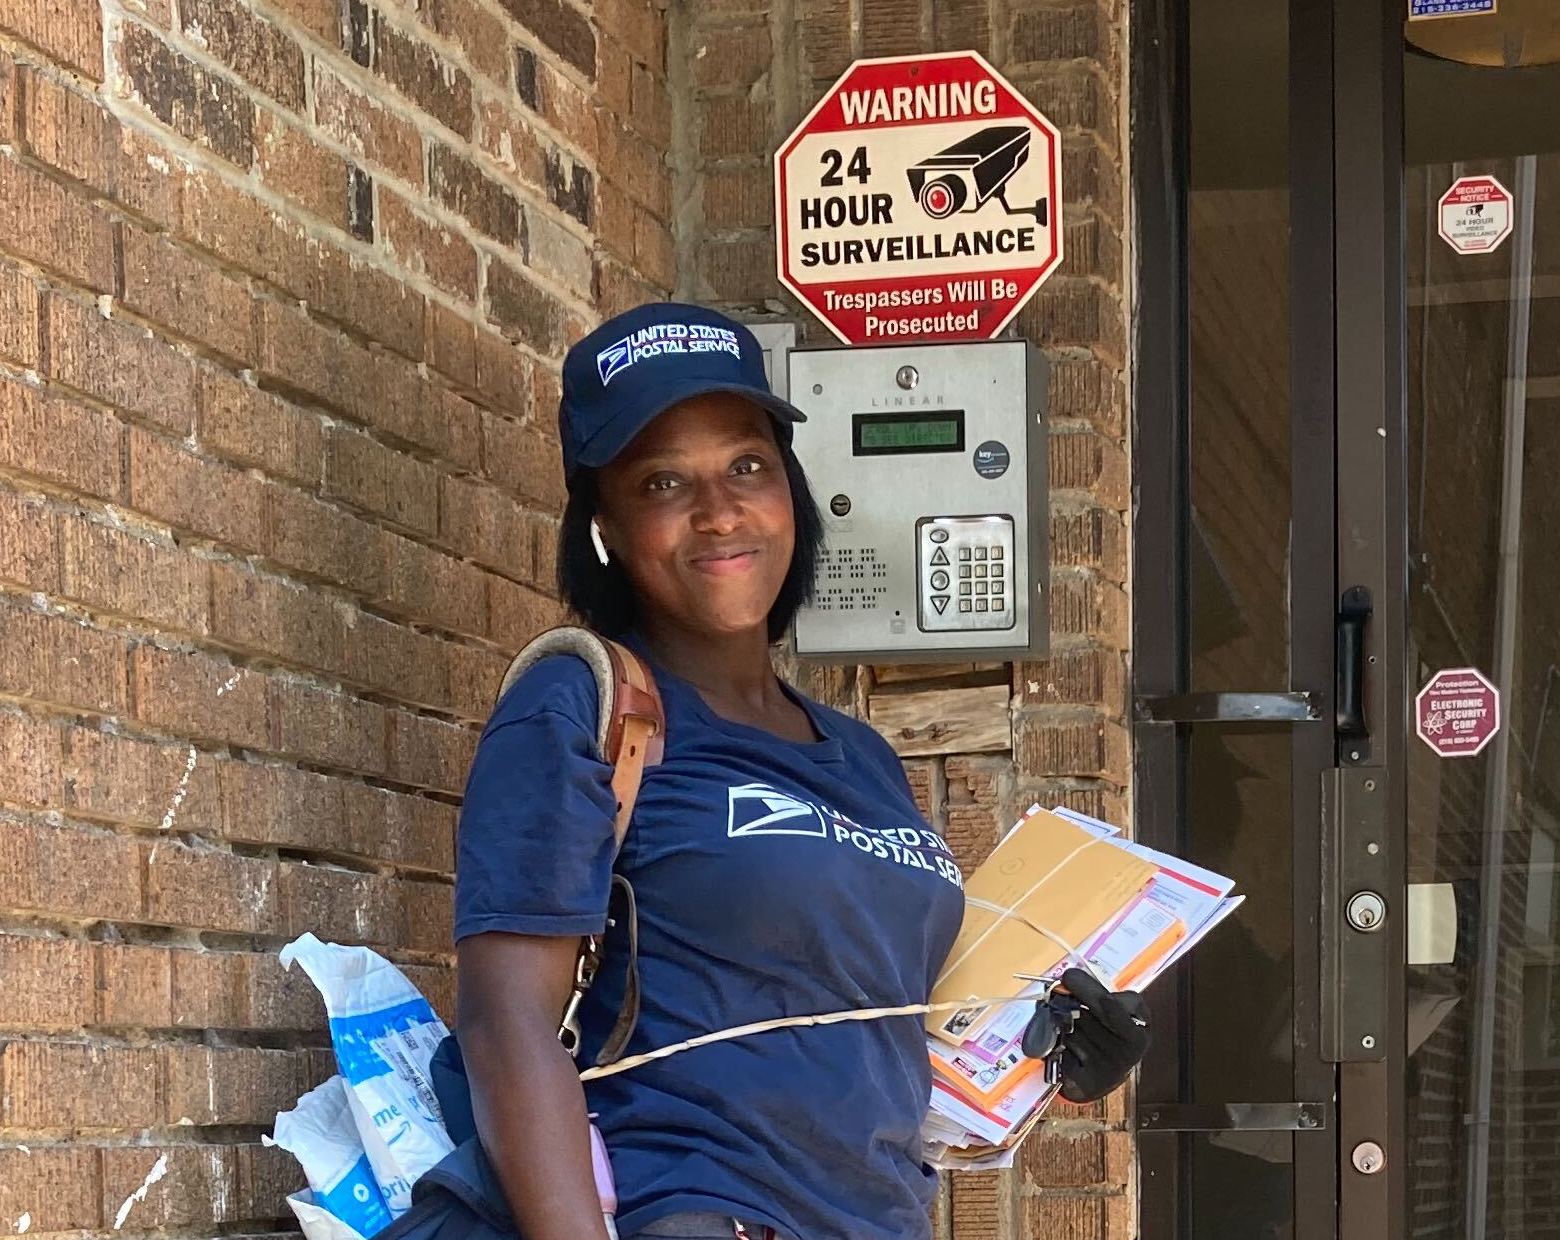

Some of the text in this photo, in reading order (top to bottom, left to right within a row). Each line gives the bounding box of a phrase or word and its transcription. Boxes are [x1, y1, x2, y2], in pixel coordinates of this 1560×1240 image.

[839, 79, 997, 125] WARNING
[820, 146, 871, 187] 24
[1455, 185, 1494, 195] SECURITY
[1460, 193, 1490, 202] NOTICE
[800, 193, 893, 230] HOUR
[1469, 217, 1494, 225] HOUR
[800, 227, 1035, 267] SURVEILLANCE
[823, 278, 1018, 313] Trespassers Will Be
[865, 310, 979, 337] Prosecuted
[631, 324, 739, 348] UNITED STATES
[633, 340, 741, 363] POSTAL SERVICE
[871, 395, 945, 407] LINEAR
[1435, 680, 1479, 688] Protection
[1431, 698, 1483, 711] ELECTRONIC
[1444, 708, 1487, 720] SECURITY
[1452, 719, 1477, 730] CORP
[833, 823, 936, 872] POSTAL
